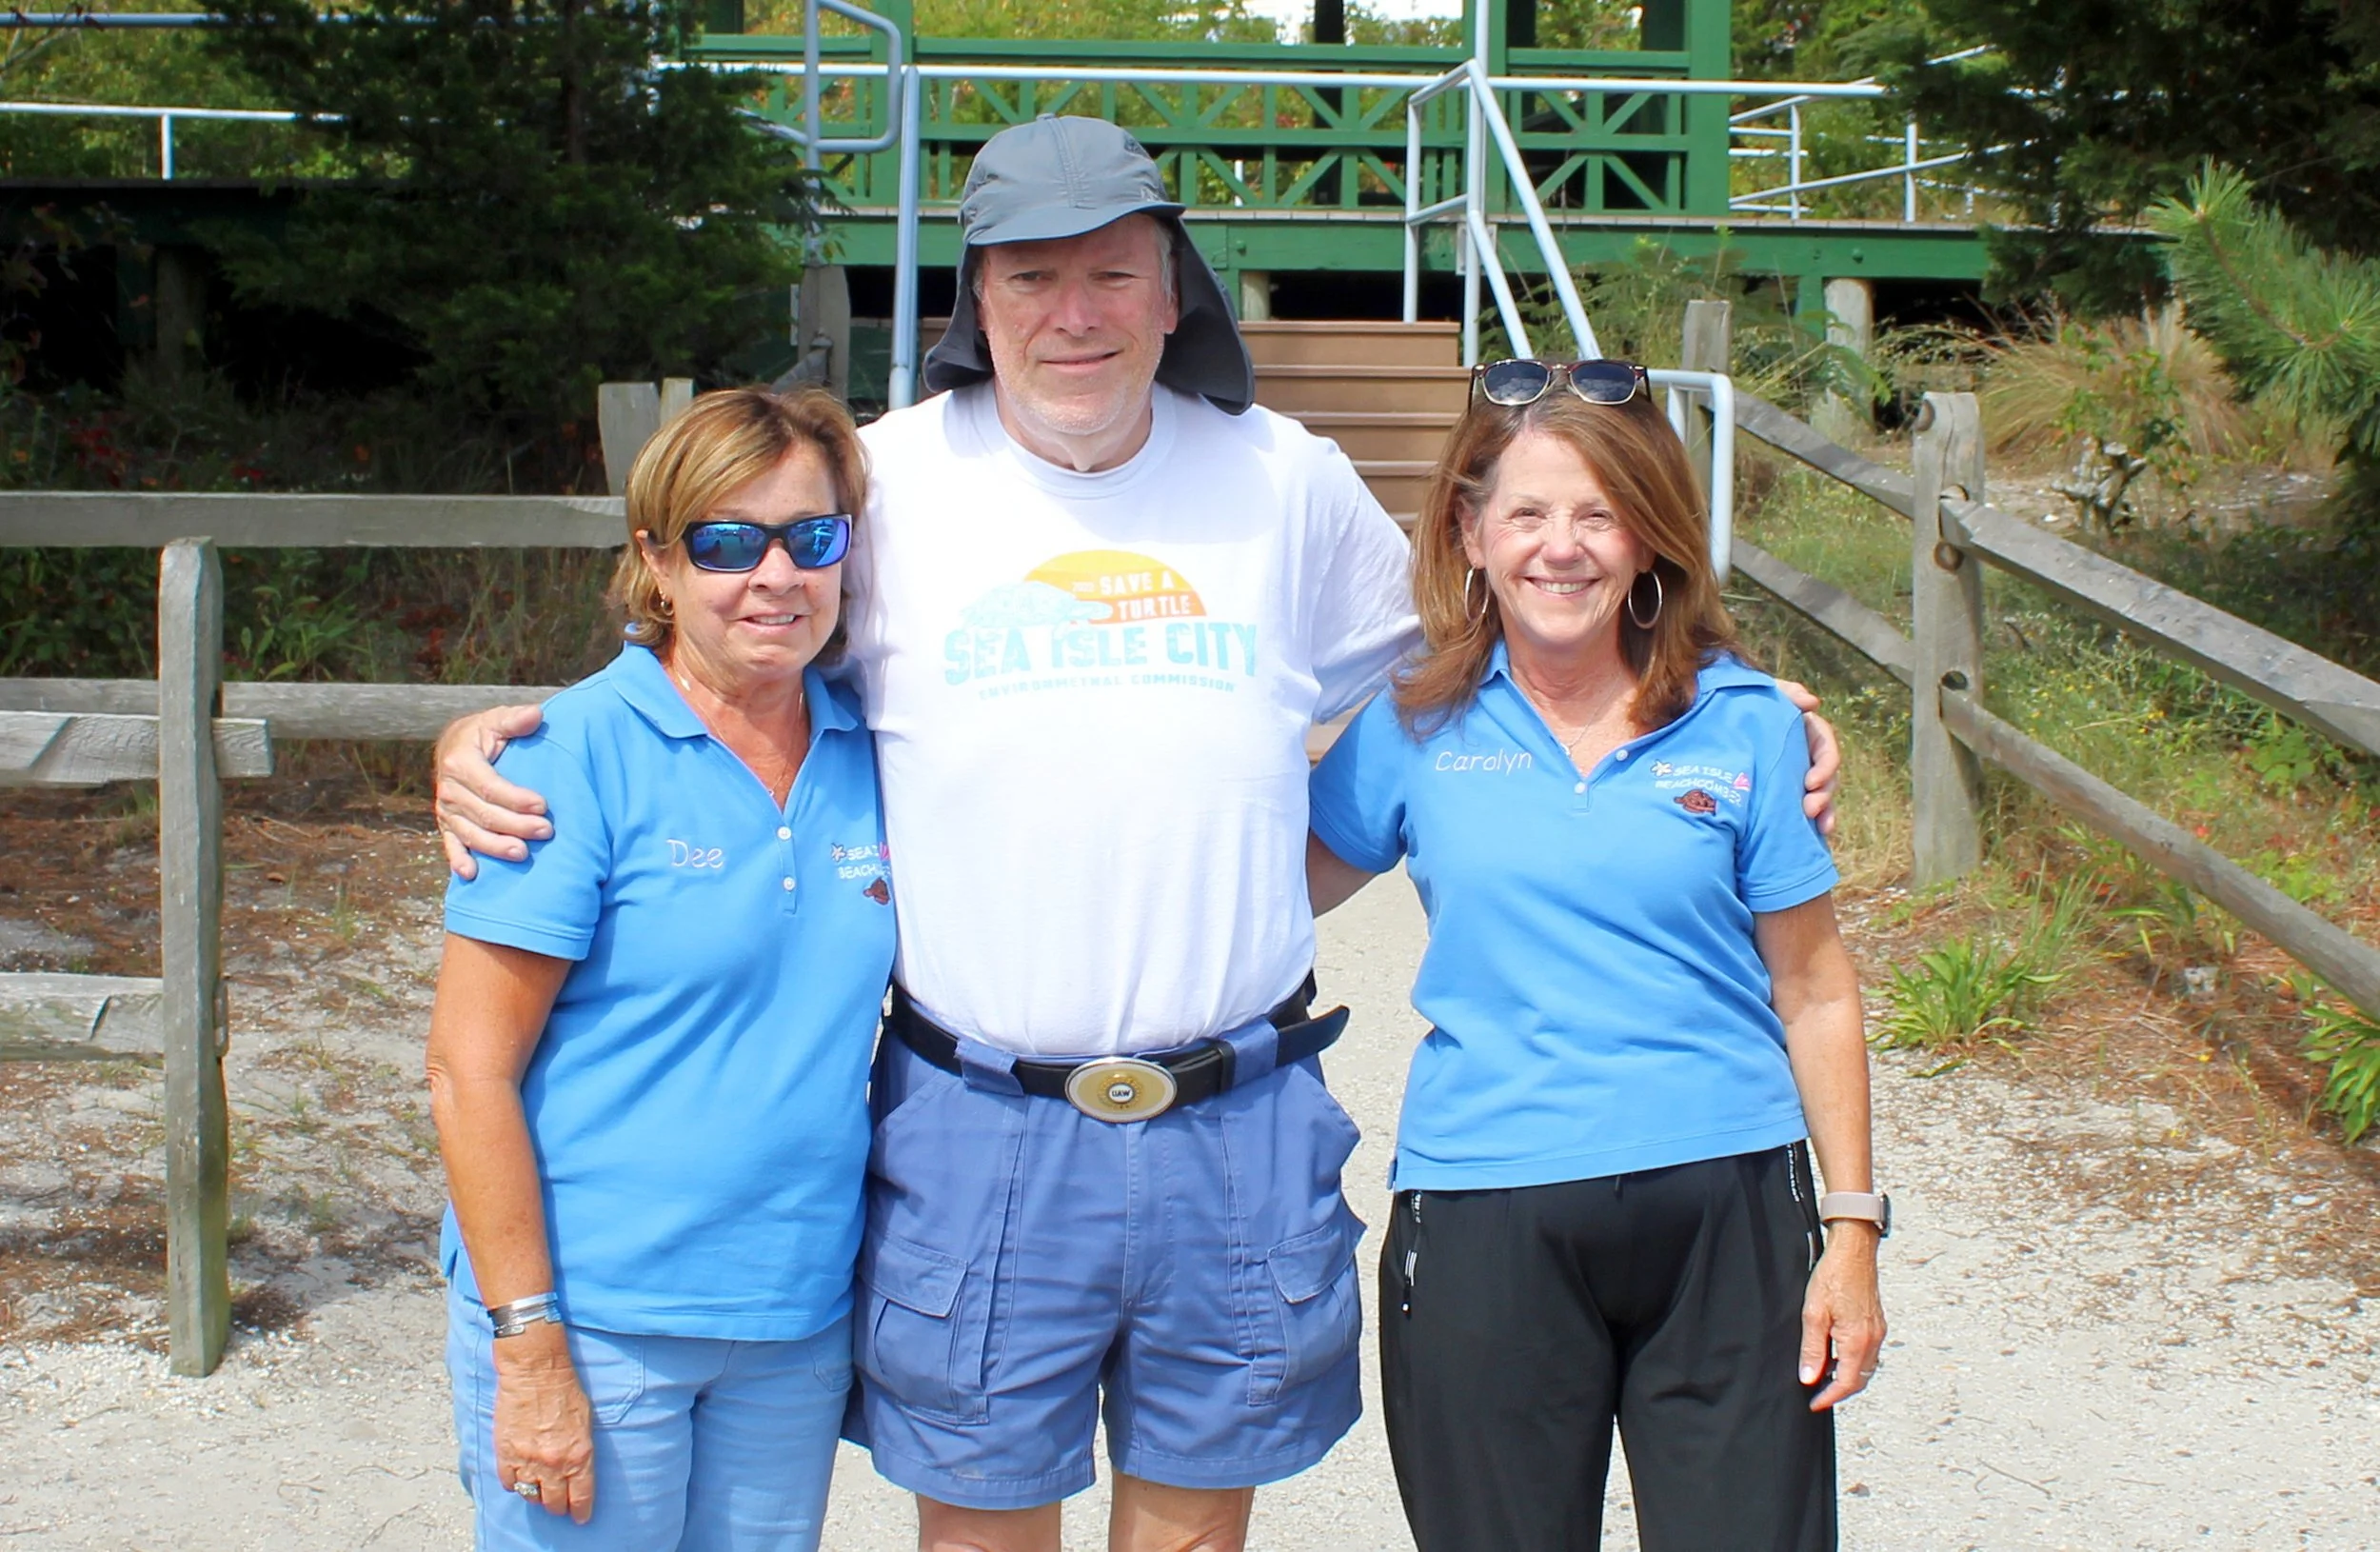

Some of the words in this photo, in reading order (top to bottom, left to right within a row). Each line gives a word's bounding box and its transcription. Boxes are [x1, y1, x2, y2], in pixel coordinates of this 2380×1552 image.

[1099, 571, 1153, 595] SAVE
[1161, 570, 1175, 589] A
[1118, 595, 1191, 621] TURTLE
[943, 627, 1032, 686] SEA
[1051, 626, 1149, 669] ISLE
[1165, 622, 1258, 677] CITY
[1130, 673, 1236, 692] COMMISSION
[1435, 748, 1533, 776] Carolyn
[1672, 765, 1699, 776] SEA
[1702, 766, 1733, 784] ISLE
[665, 838, 724, 868] Dee
[846, 845, 873, 861] SEA
